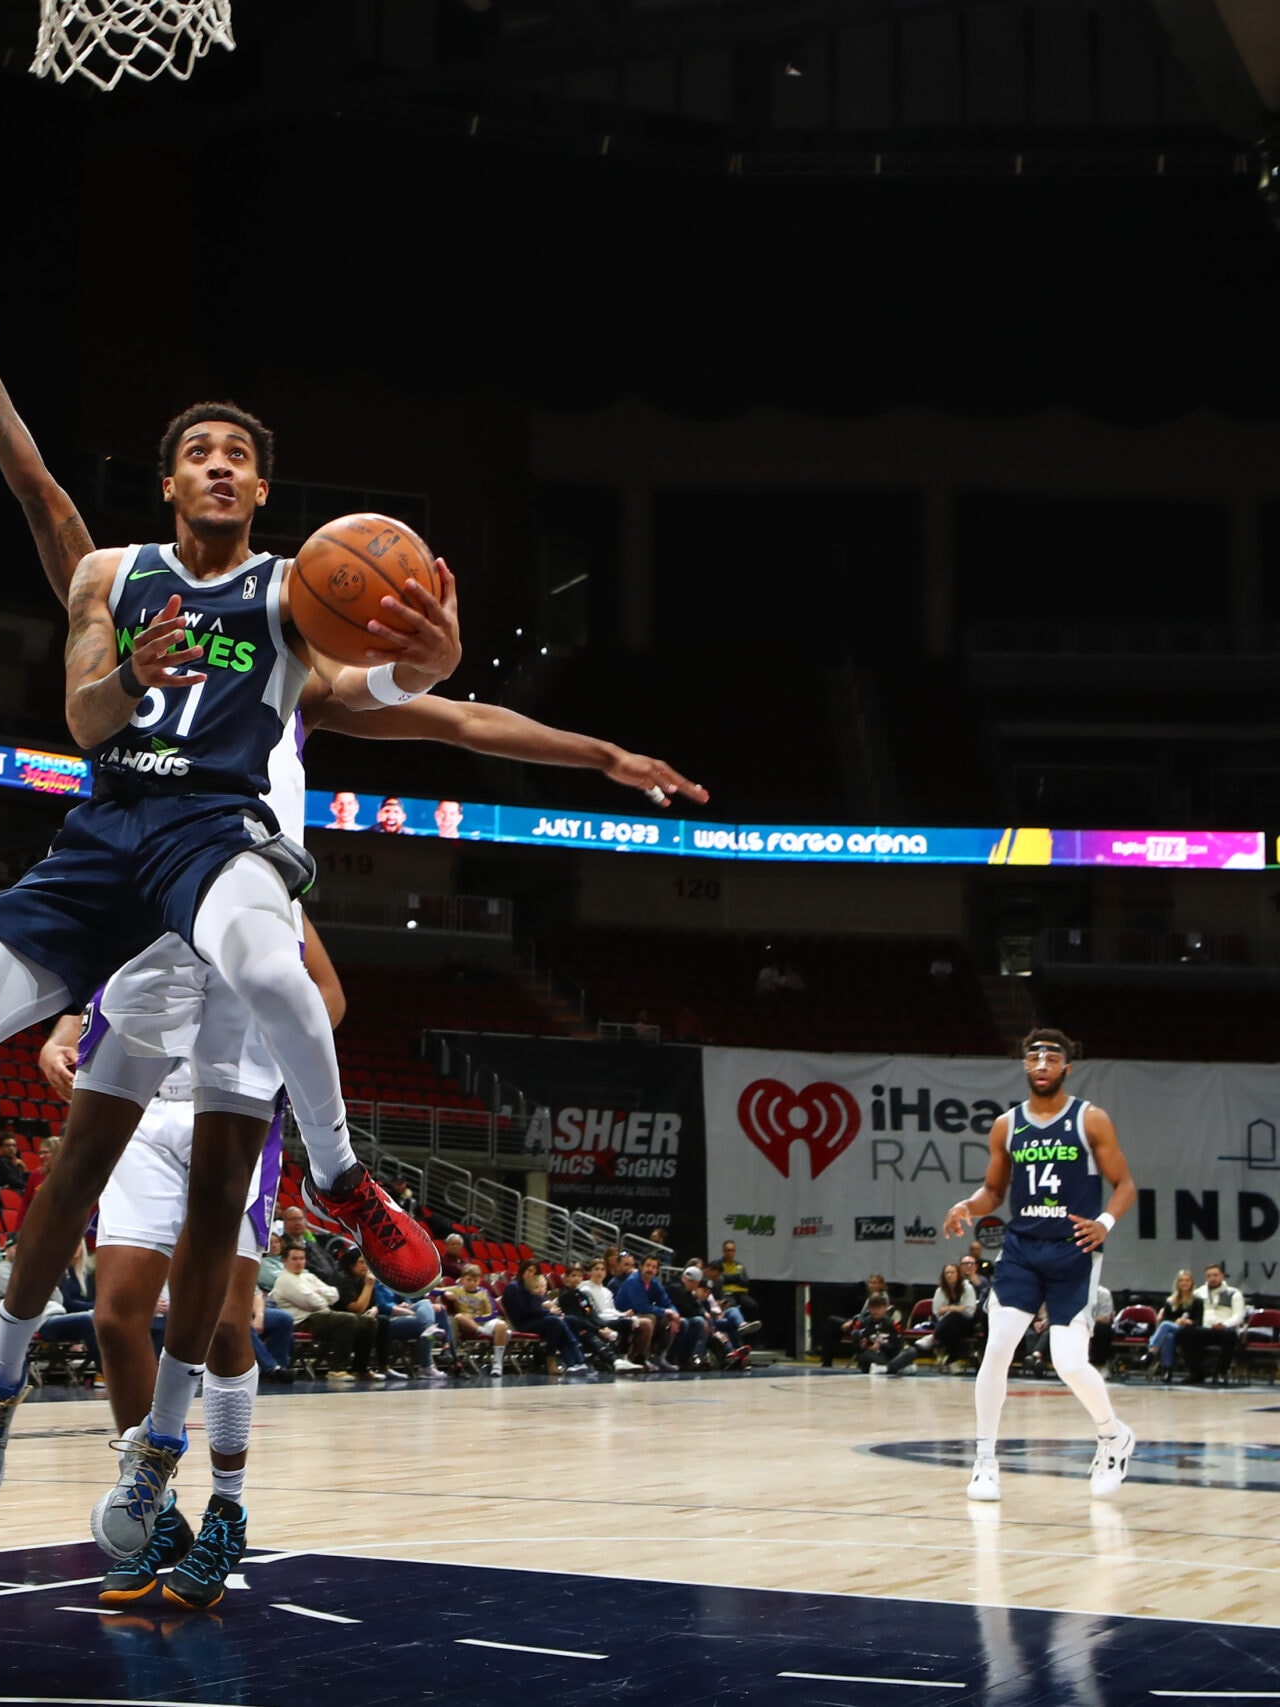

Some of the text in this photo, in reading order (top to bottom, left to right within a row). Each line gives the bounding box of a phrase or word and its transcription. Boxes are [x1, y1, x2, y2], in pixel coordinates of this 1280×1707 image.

[140, 608, 224, 633] IWA
[531, 816, 580, 839] JULY
[600, 821, 660, 845] 2023
[672, 877, 720, 900] 120
[872, 1084, 1019, 1135] iHea
[1012, 1146, 1079, 1163] WOLVES
[1023, 1138, 1062, 1148] IOWA
[1025, 1162, 1062, 1196] 14
[1021, 1205, 1067, 1218] LANDUS
